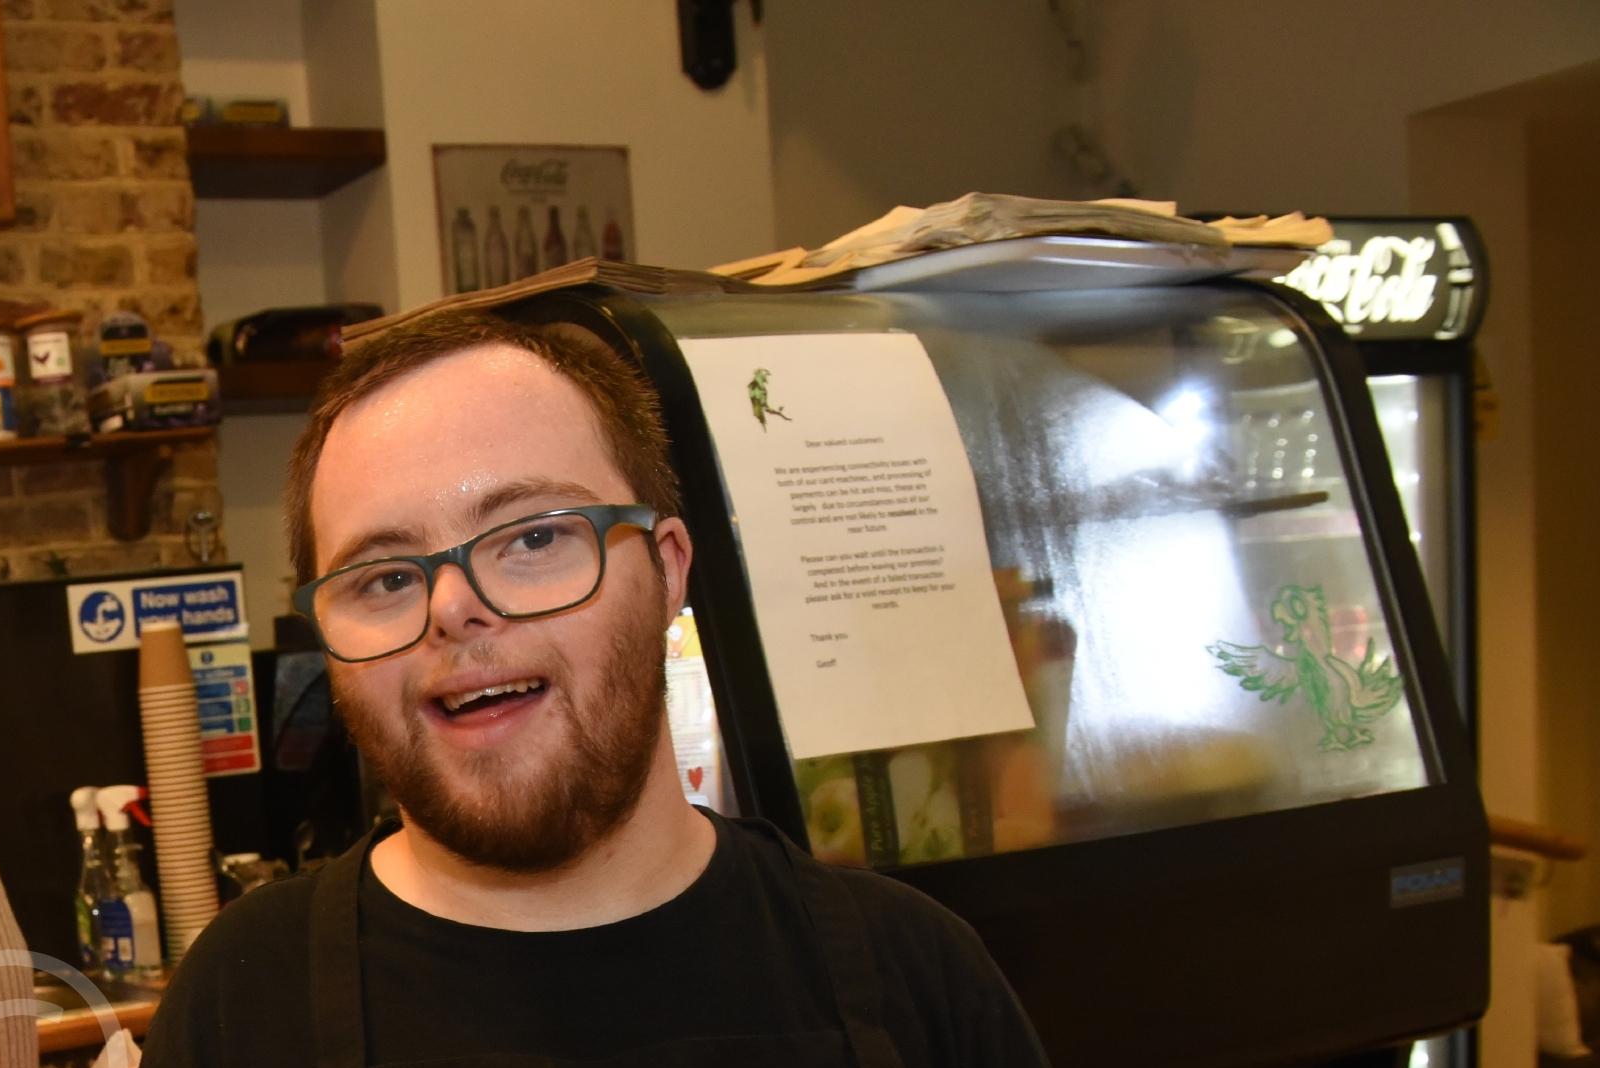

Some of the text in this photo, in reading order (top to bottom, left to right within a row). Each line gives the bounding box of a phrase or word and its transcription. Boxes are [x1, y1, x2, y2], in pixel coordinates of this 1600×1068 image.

[140, 584, 230, 610] Now wash
[182, 607, 236, 626] hands
